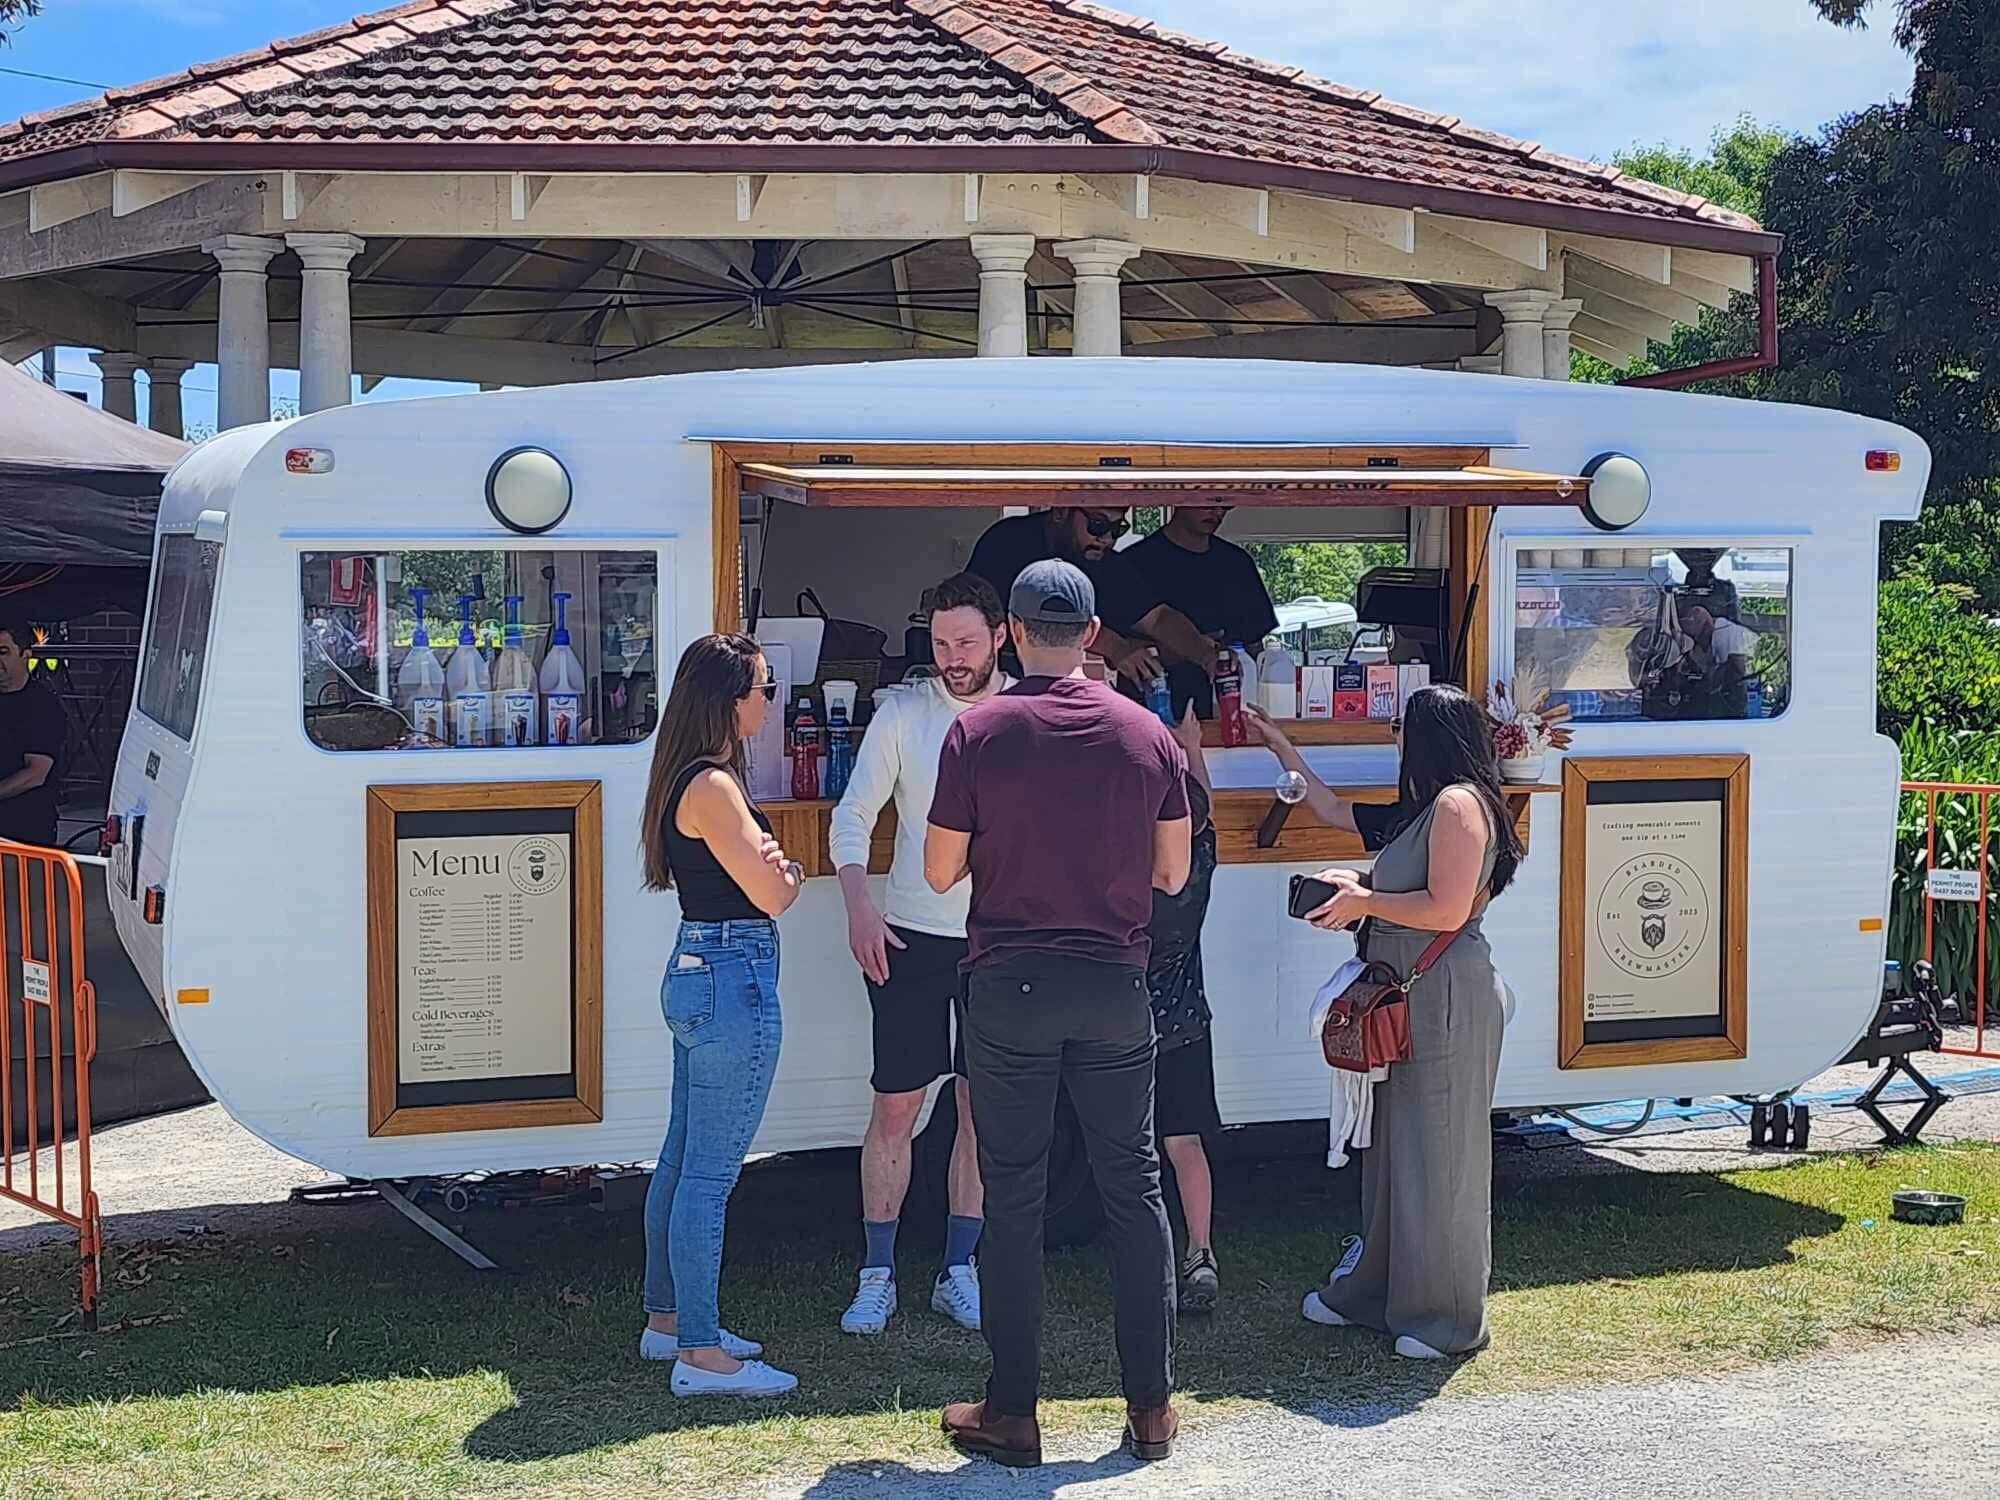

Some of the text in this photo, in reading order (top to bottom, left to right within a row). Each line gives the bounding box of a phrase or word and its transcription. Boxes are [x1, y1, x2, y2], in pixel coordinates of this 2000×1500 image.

[1602, 822, 1634, 830] Crafting
[1637, 820, 1671, 828] memorable
[412, 849, 500, 877] Menu
[1625, 860, 1681, 877] BEARDED
[409, 886, 446, 898] Coffee
[1606, 912, 1621, 920] Est
[1614, 944, 1690, 972] BREWMASTER
[411, 966, 437, 976] Teas
[412, 1007, 495, 1021] Cold Beverages
[412, 1041, 447, 1053] Extras
